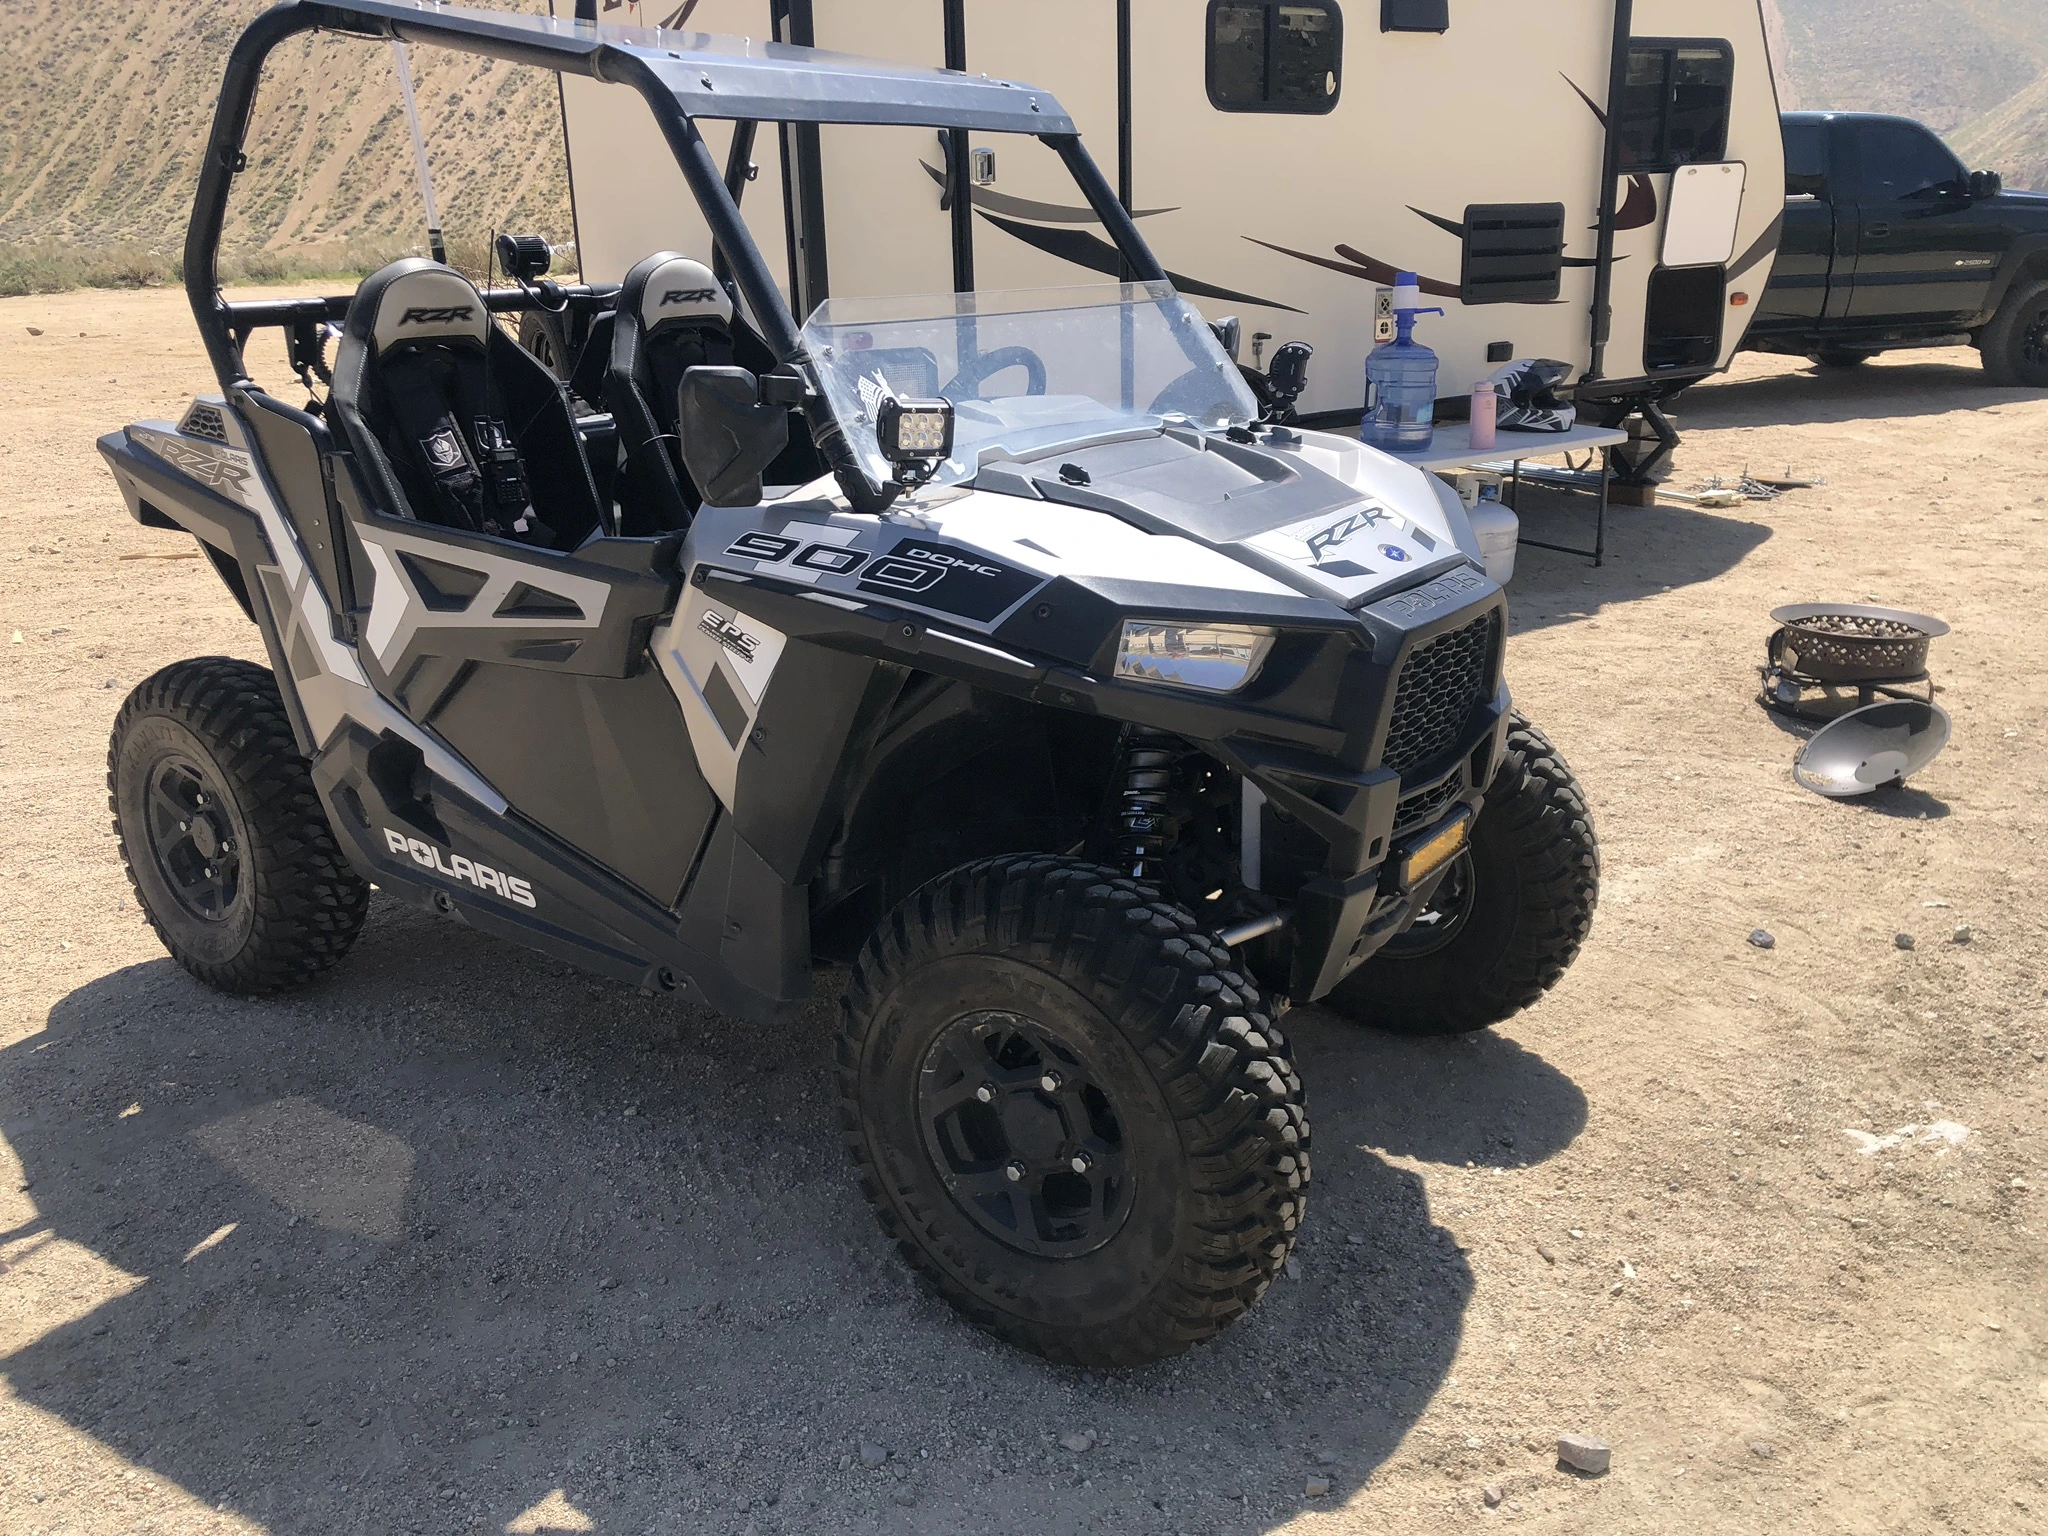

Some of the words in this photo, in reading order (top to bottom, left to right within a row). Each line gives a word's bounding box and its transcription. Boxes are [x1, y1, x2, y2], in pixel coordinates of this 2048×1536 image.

[398, 305, 474, 327] RZR
[659, 288, 717, 307] RZR
[159, 437, 254, 497] RZR
[215, 447, 248, 467] POLARIS
[1305, 506, 1394, 566] RZR
[722, 530, 948, 593] 900
[906, 548, 1002, 577] DOHC
[702, 610, 760, 651] EPS
[382, 827, 537, 908] POLARIS
